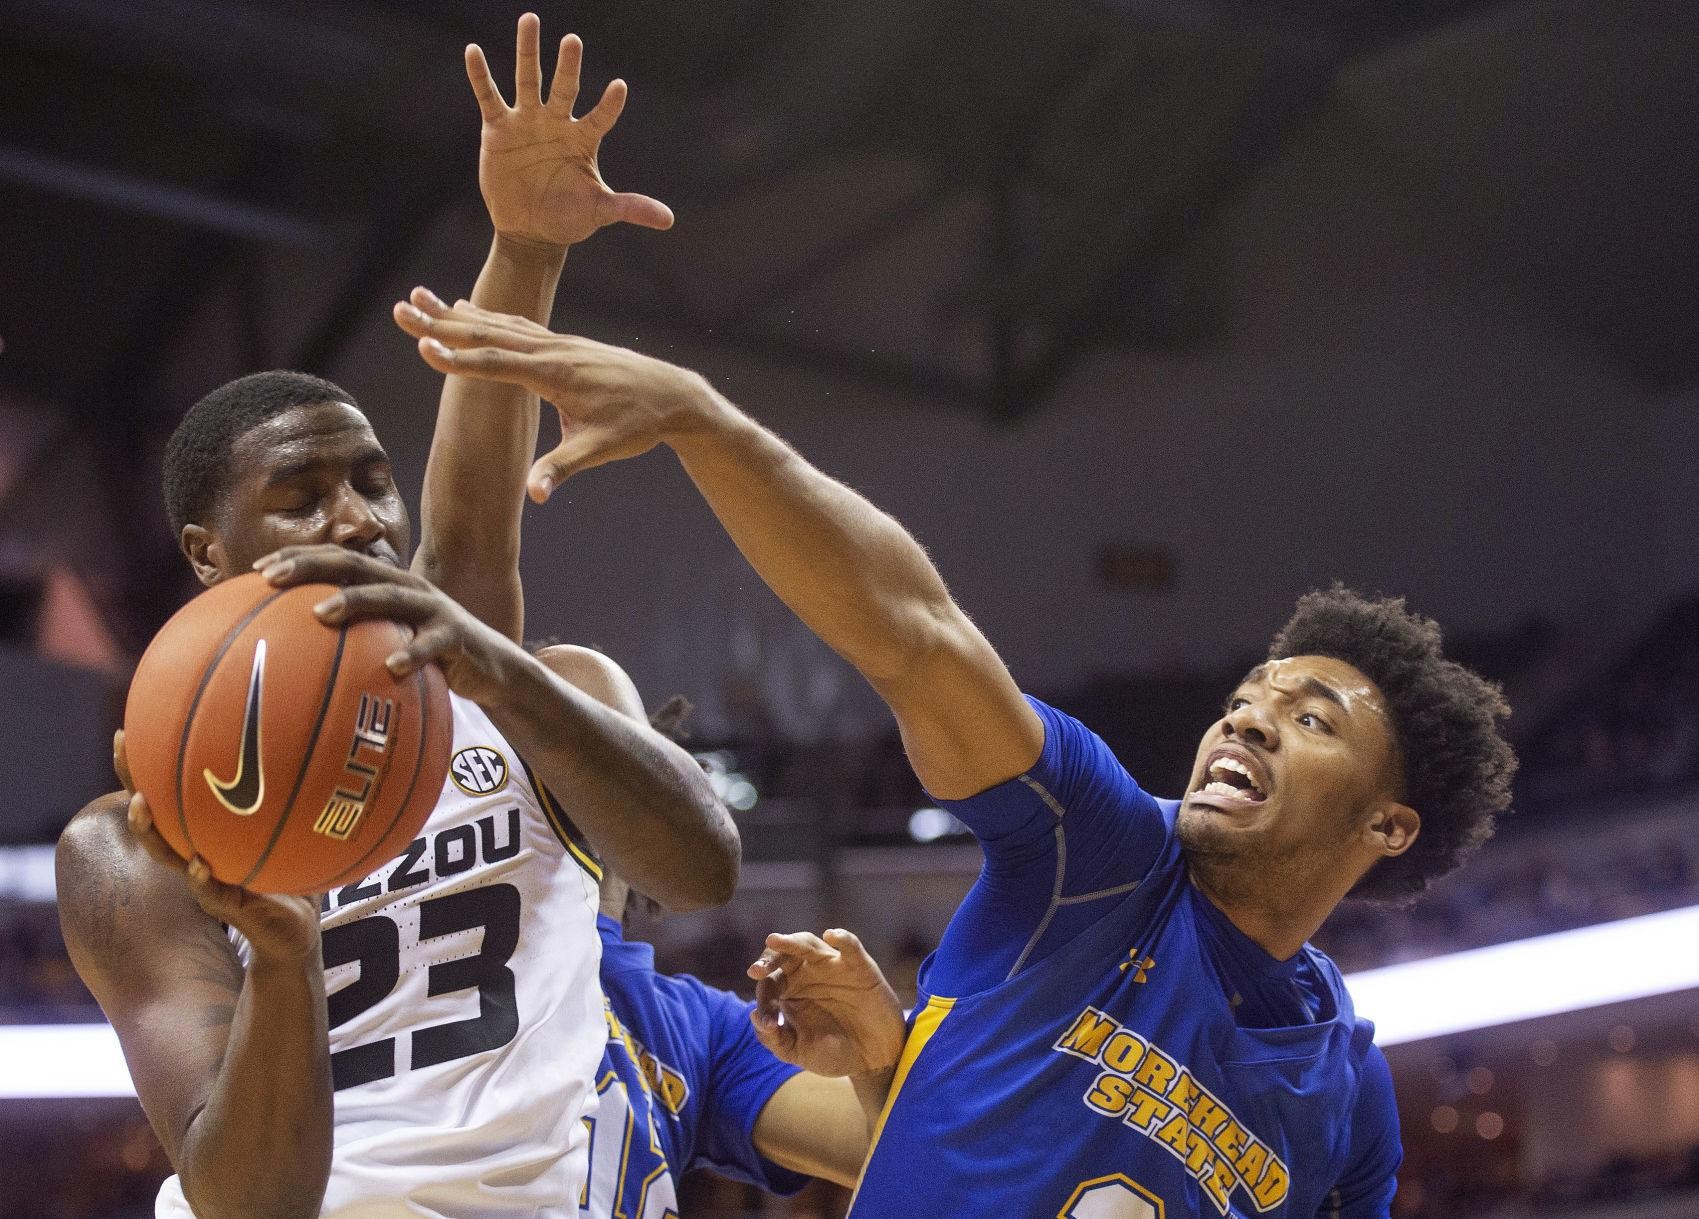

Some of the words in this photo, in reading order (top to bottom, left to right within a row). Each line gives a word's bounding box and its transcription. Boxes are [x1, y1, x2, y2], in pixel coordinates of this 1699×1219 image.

[313, 691, 393, 840] ELITE
[451, 747, 505, 792] SEC
[322, 883, 521, 1091] 23
[1052, 1005, 1290, 1213] MOREHEAD
[1083, 1069, 1240, 1216] STATE
